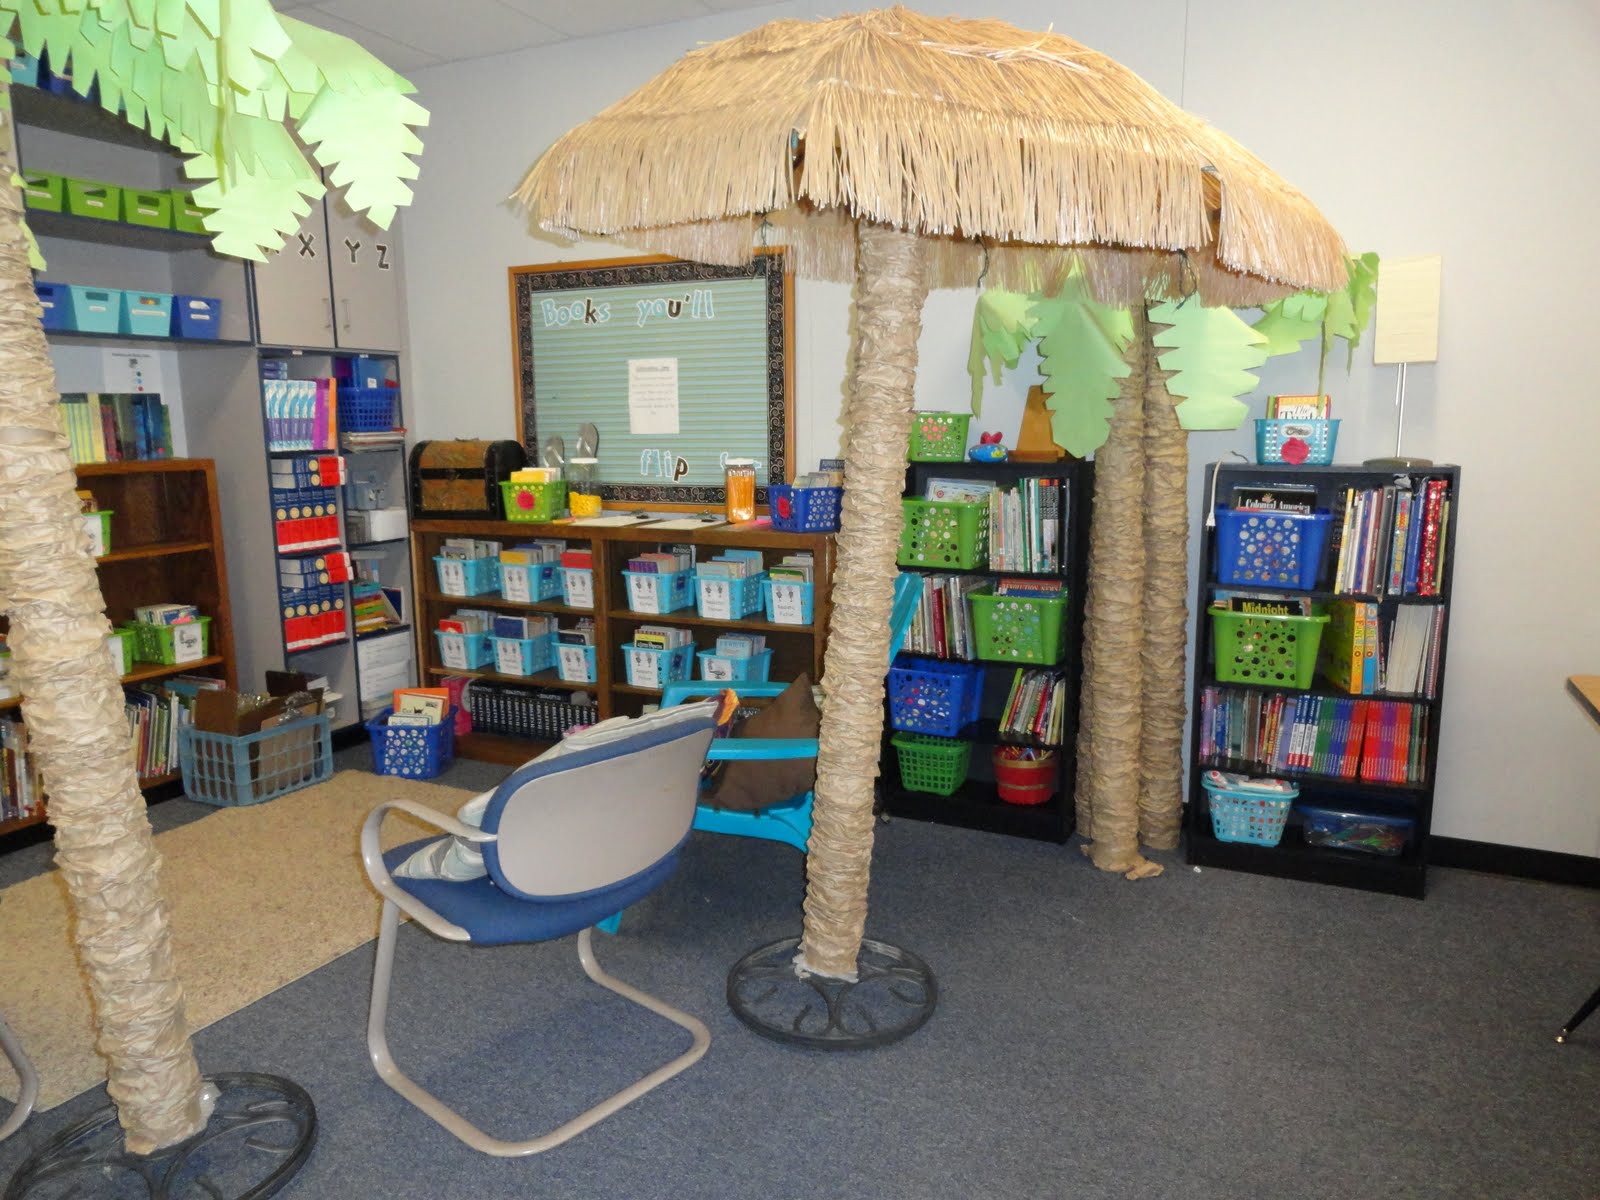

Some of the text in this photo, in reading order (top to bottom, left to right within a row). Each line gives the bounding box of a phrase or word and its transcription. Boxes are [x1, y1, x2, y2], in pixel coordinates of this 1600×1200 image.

[298, 232, 316, 258] X
[344, 237, 389, 269] Y Z
[541, 289, 715, 328] Books you'll
[640, 448, 690, 484] flip
[1242, 601, 1289, 615] Midnight
